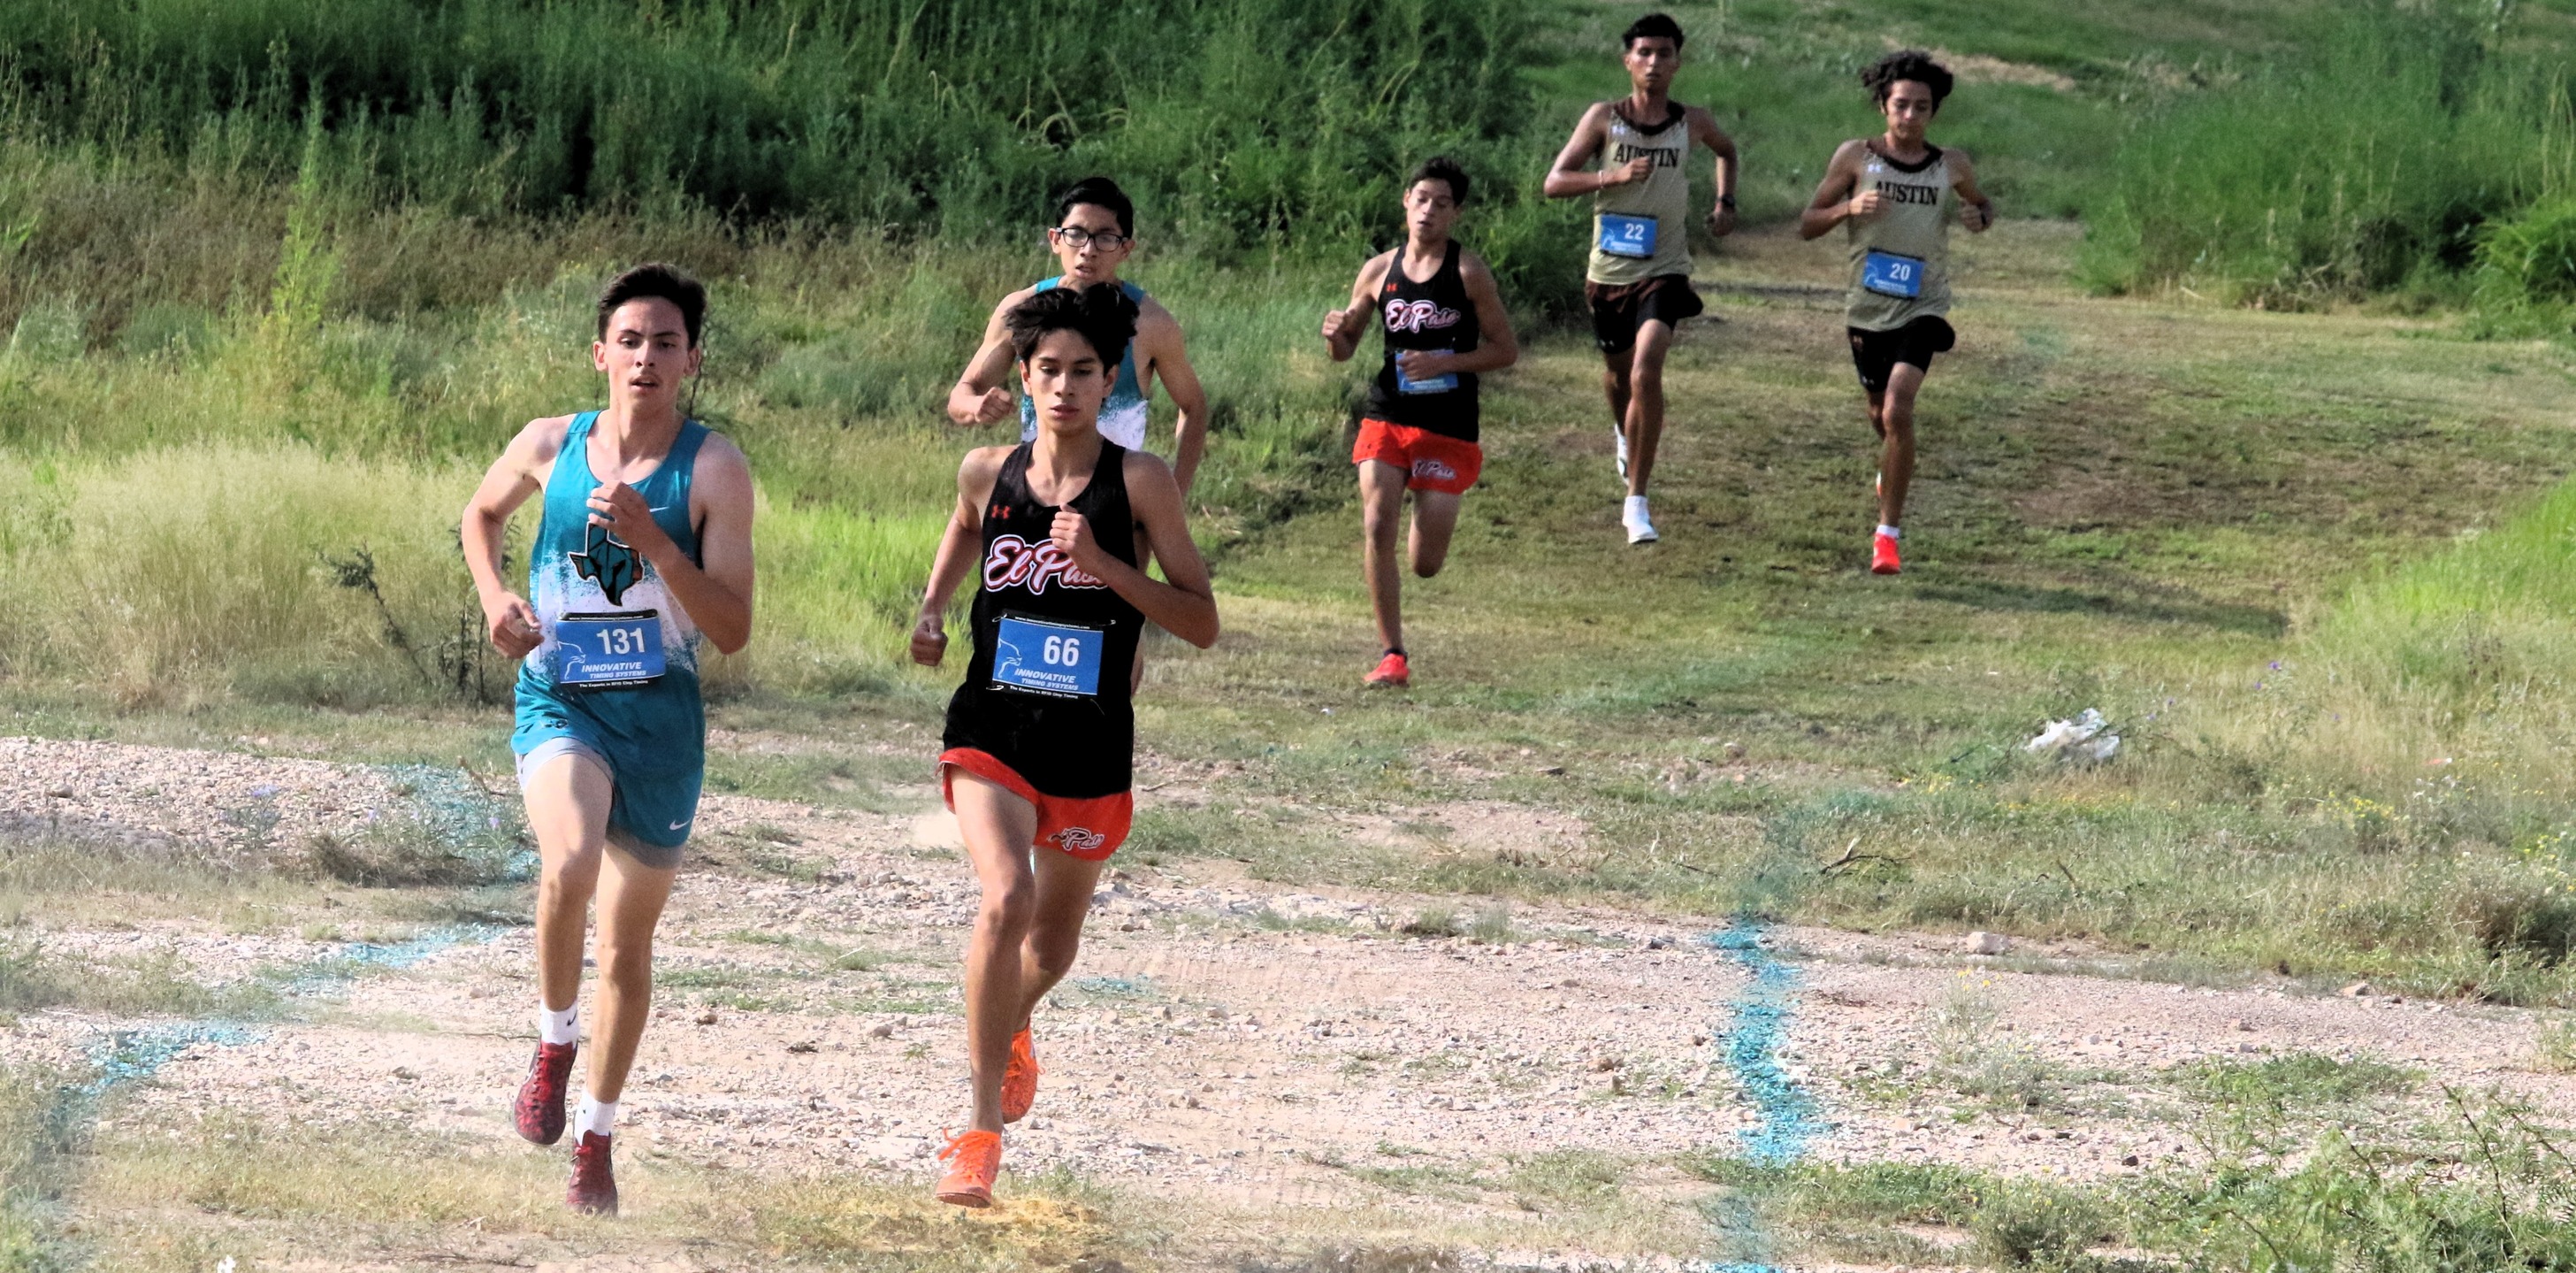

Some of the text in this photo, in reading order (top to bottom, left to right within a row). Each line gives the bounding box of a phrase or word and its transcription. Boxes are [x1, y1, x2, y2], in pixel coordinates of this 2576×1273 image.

[1613, 143, 1680, 167] AUSTIN
[1876, 180, 1939, 205] AUSTIN
[1624, 223, 1645, 241] 22
[1889, 263, 1911, 281] 20
[1385, 299, 1462, 334] El Paso
[985, 534, 1108, 595] El Pas
[596, 627, 645, 655] 131
[1043, 635, 1081, 667] 66
[581, 662, 642, 672] INNOVATIVE
[1014, 668, 1076, 684] INNOVATIVE
[1021, 678, 1079, 691] TIMING SYSTEMS
